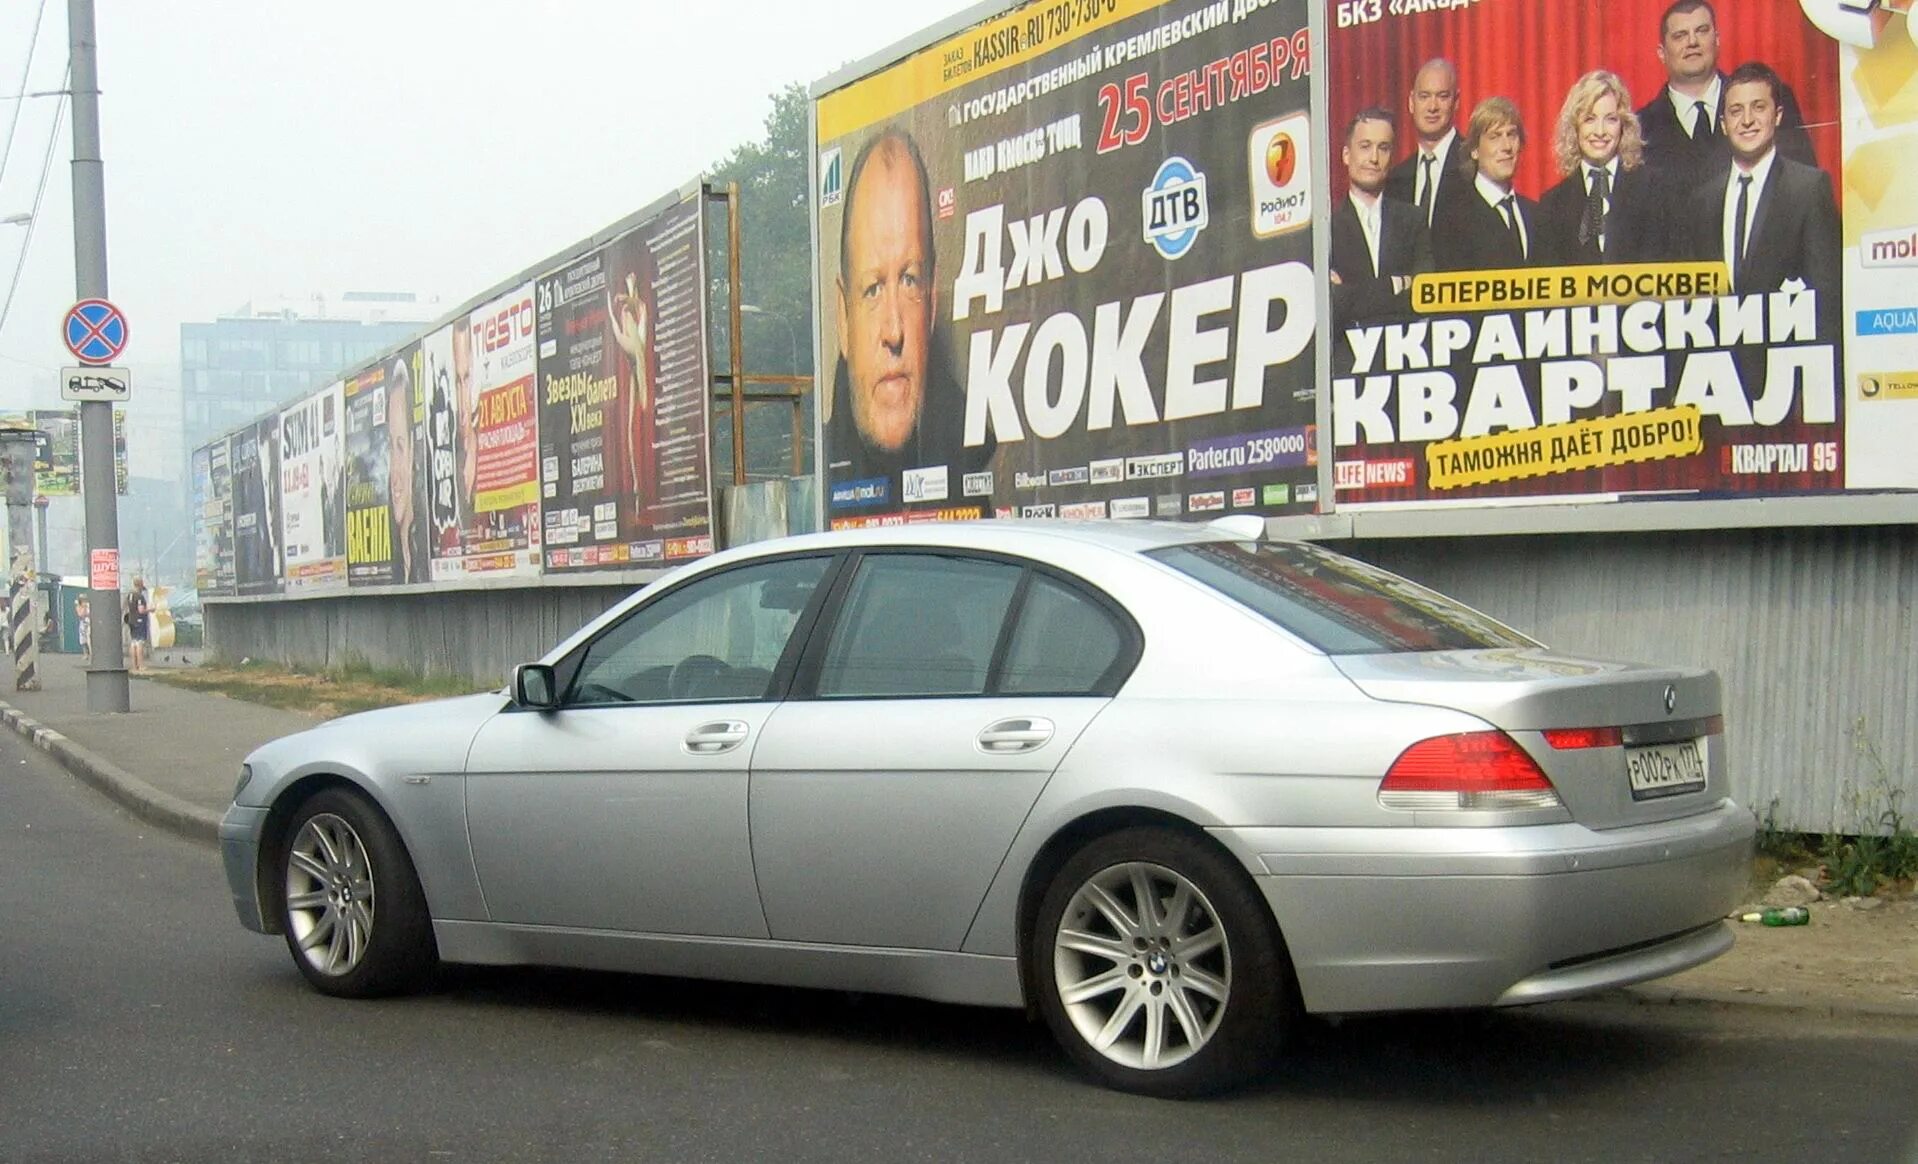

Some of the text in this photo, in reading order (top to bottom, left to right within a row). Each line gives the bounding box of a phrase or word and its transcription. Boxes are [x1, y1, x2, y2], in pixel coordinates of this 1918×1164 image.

[1337, 0, 1382, 28] БКЗ
[964, 45, 1102, 122] ГОСУДАРСТВЕННЫЙ
[1097, 27, 1311, 155] 25 СЕНТЯБРЯ
[1046, 113, 1082, 155] TOUR
[1149, 187, 1200, 230] ДТВ
[952, 197, 1109, 321] Джо
[538, 281, 552, 313] 26
[1420, 271, 1720, 305] ВПЕРВЫЕ В МОСКВЕ!
[1345, 278, 1817, 374] УКРАИНСКИЙ
[963, 261, 1316, 447] КОКЕР
[491, 384, 528, 425] АВГУСТА
[546, 371, 617, 406] Звезды балета
[1333, 345, 1837, 447] КВАРТАЛ
[570, 402, 587, 434] XXI
[1188, 434, 1304, 472] Parter.ru 2580000
[1436, 418, 1694, 477] ТАМОЖНЯ ДАЁТ ДОБРО!
[1731, 442, 1837, 474] КВАРТАЛ 95
[1137, 461, 1183, 477] ЭКСПЕРТ
[1366, 461, 1406, 484] NEWS
[347, 504, 392, 564] ВАЕНГА
